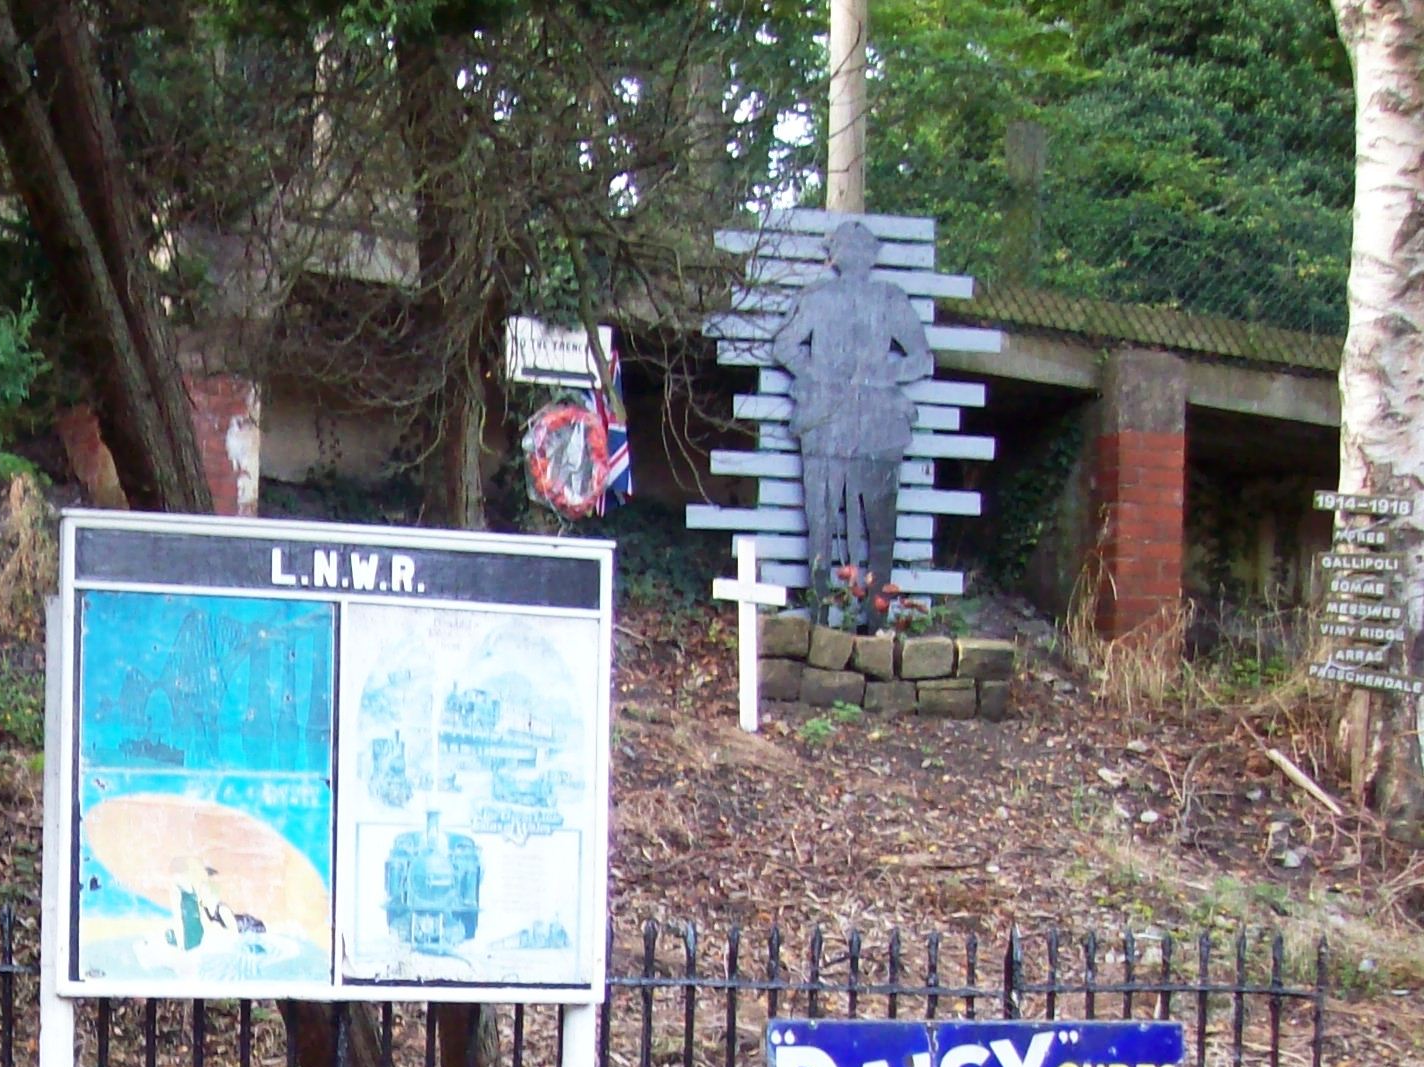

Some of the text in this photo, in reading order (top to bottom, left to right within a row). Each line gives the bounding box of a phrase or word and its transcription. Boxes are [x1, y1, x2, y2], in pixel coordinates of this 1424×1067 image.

[1315, 494, 1410, 515] 1914-1918
[270, 547, 426, 593] L.N.W.R.
[1321, 556, 1399, 571] GALLIPOLI
[1330, 579, 1385, 595] SOMME
[1326, 601, 1401, 619] MESSINES
[1319, 623, 1405, 642] VIMY RIDGE
[1335, 649, 1384, 663] ARRAS
[1309, 664, 1423, 694] PASSCHENDALE
